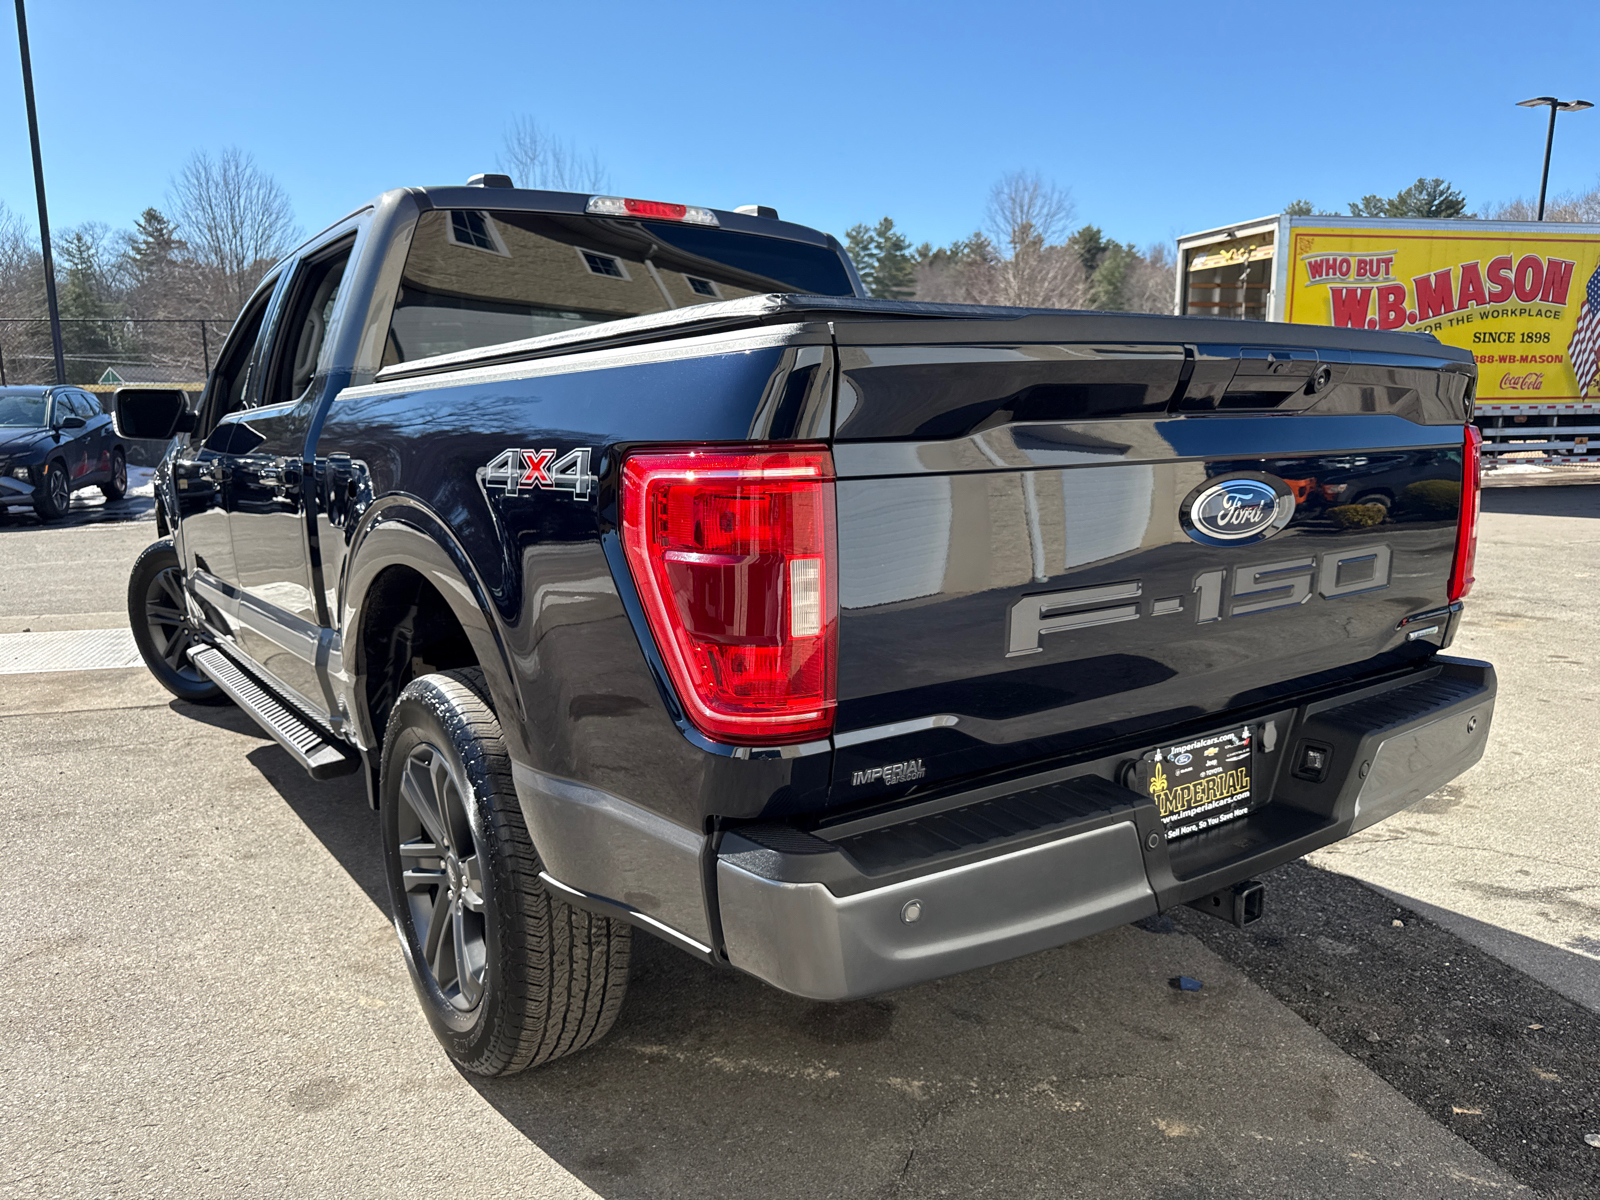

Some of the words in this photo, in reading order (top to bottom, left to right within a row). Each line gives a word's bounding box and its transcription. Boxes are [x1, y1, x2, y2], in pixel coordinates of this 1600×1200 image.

[1305, 255, 1351, 281] WHO
[1355, 255, 1395, 280] BUT
[1448, 313, 1474, 328] THE
[1479, 308, 1562, 320] WORKPLACE
[1473, 332, 1516, 344] SINCE
[1520, 332, 1551, 344] 1898
[1499, 372, 1546, 391] Coca-Cola
[1216, 493, 1265, 527] Ford
[1004, 541, 1394, 657] F-150
[1170, 733, 1235, 755] Imperialcars.com
[852, 758, 926, 786] IMPERIAL
[885, 771, 926, 786] cars.com
[1154, 767, 1250, 817] IMPERIAL
[1160, 791, 1250, 824] ww.imperialcars.com
[1167, 829, 1180, 839] Sell
[1198, 820, 1208, 829] So
[1207, 817, 1220, 826] You
[1219, 812, 1234, 822] Save
[1234, 807, 1249, 817] More
